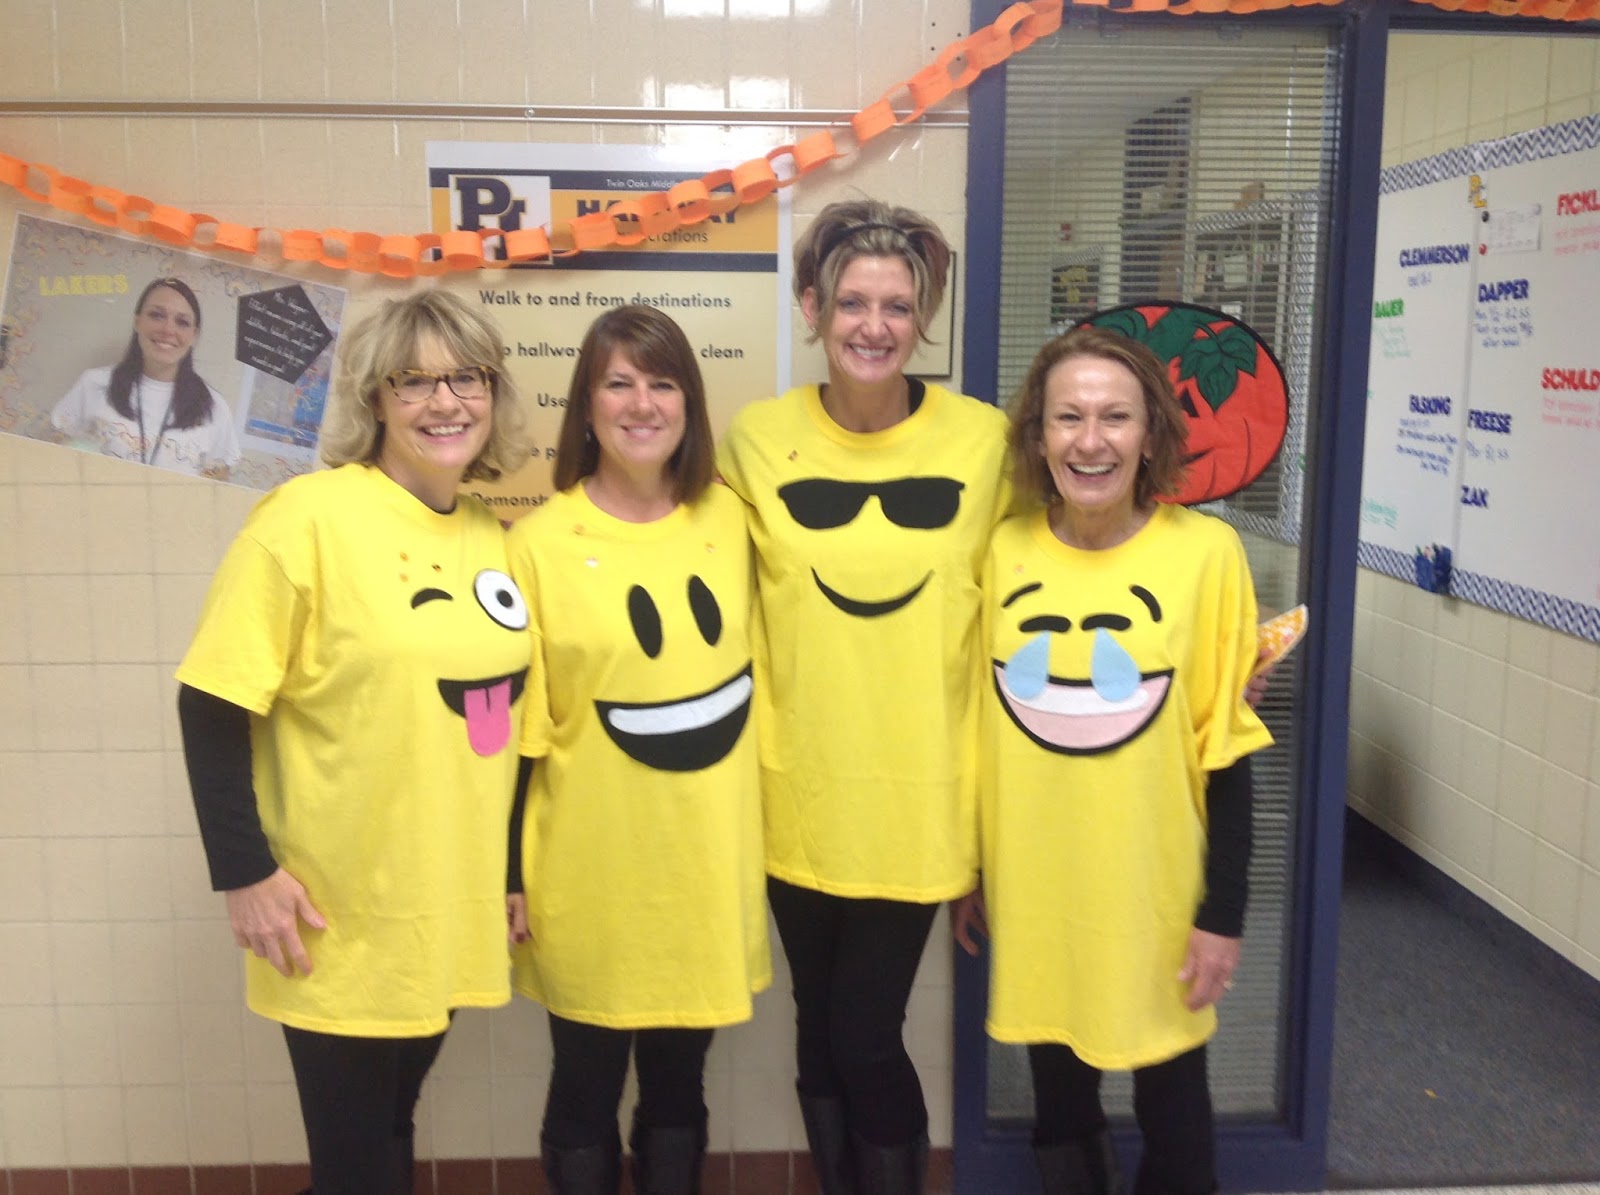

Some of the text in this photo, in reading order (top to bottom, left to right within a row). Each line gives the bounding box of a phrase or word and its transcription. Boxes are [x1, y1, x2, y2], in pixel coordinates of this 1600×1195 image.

[606, 178, 626, 188] Twin
[627, 178, 648, 188] Oaks
[39, 274, 128, 296] LAKERS
[1478, 279, 1529, 302] DAPPER
[479, 290, 732, 308] Walk to and from destinations
[701, 343, 744, 358] clean
[537, 393, 568, 407] Use
[1469, 409, 1512, 434] FREESE
[471, 492, 549, 507] emonst
